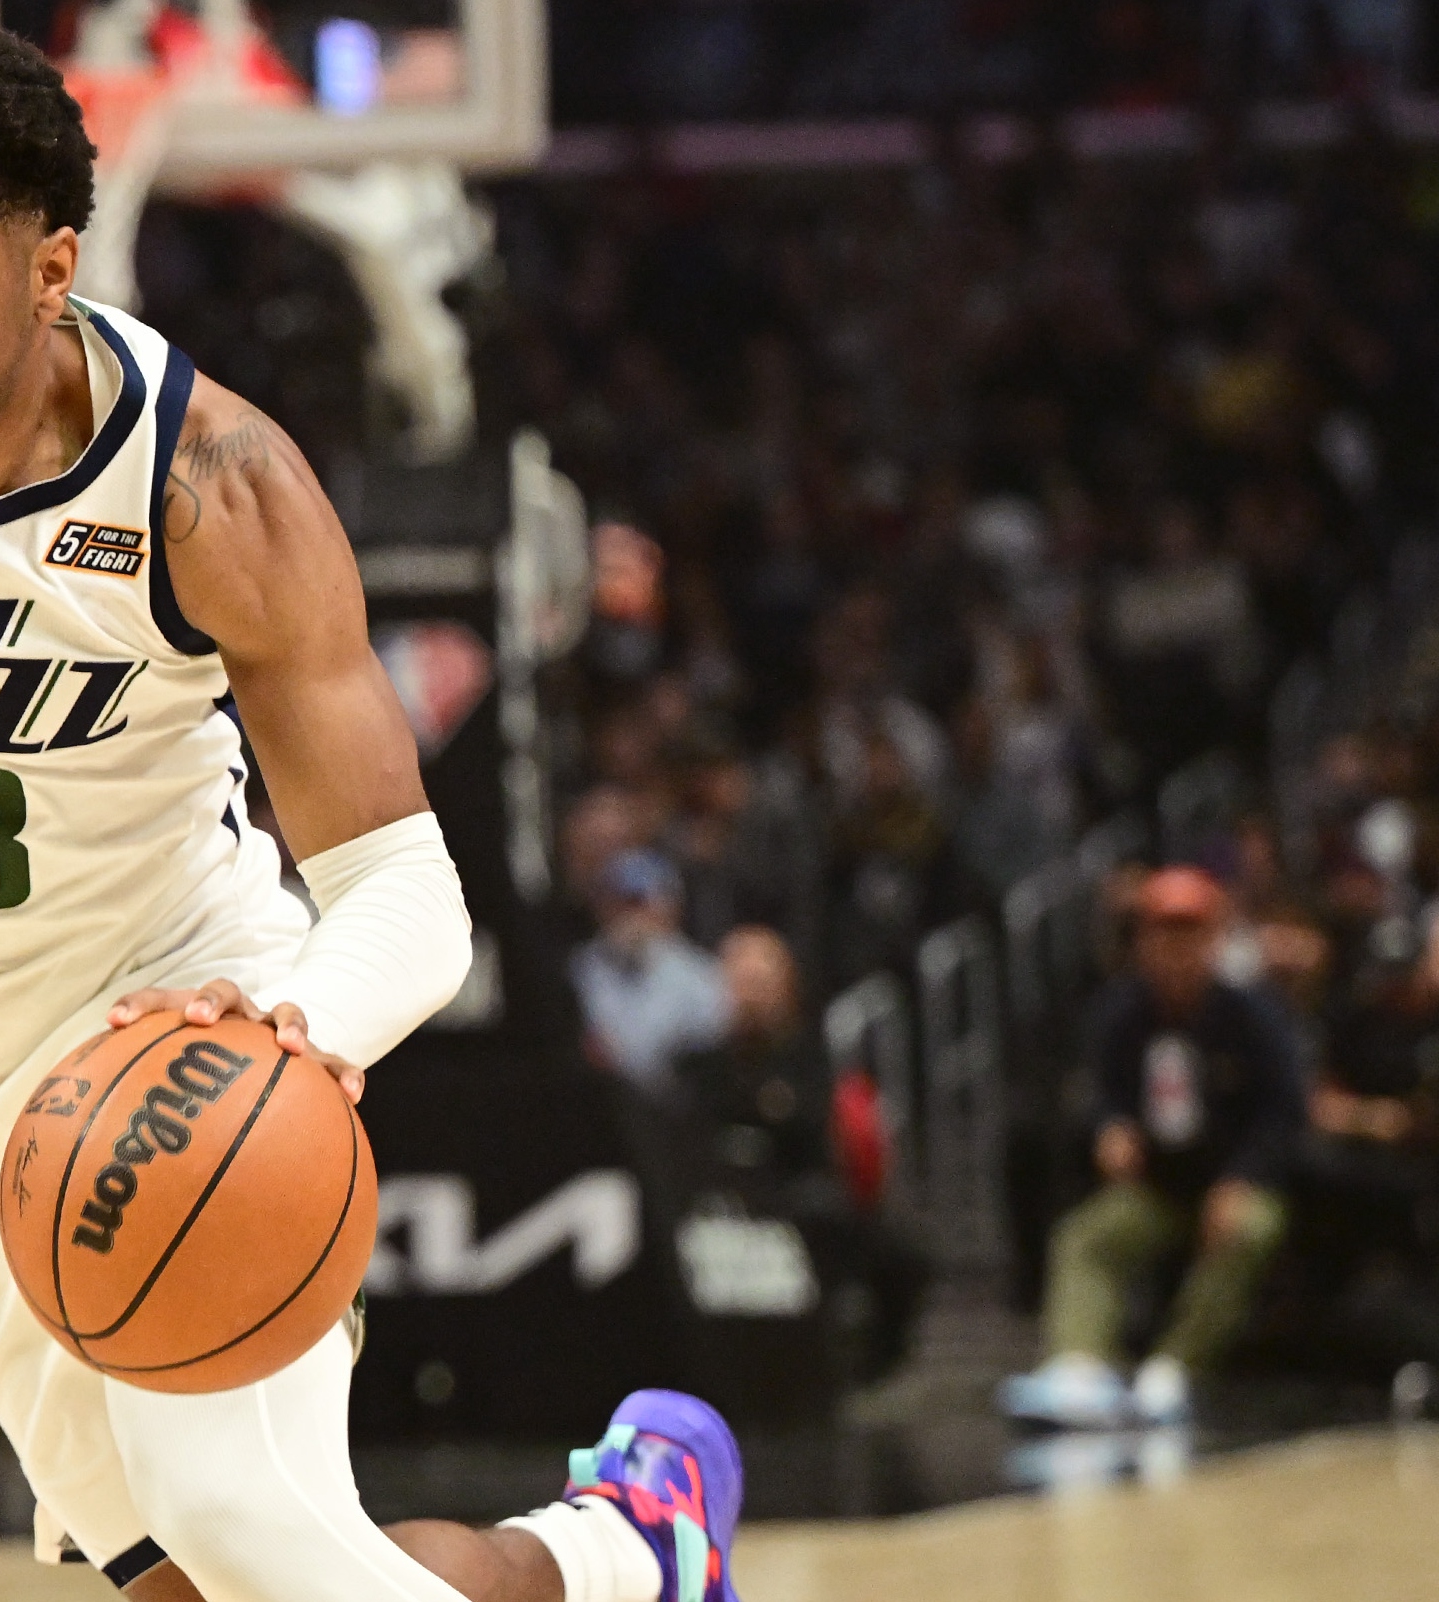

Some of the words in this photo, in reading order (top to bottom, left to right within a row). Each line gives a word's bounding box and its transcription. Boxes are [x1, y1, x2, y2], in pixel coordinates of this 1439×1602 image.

[52, 524, 88, 563] 5
[97, 529, 119, 542] FOR
[120, 532, 139, 546] THE
[81, 548, 139, 572] FIGHT
[70, 1039, 256, 1256] Wilson
